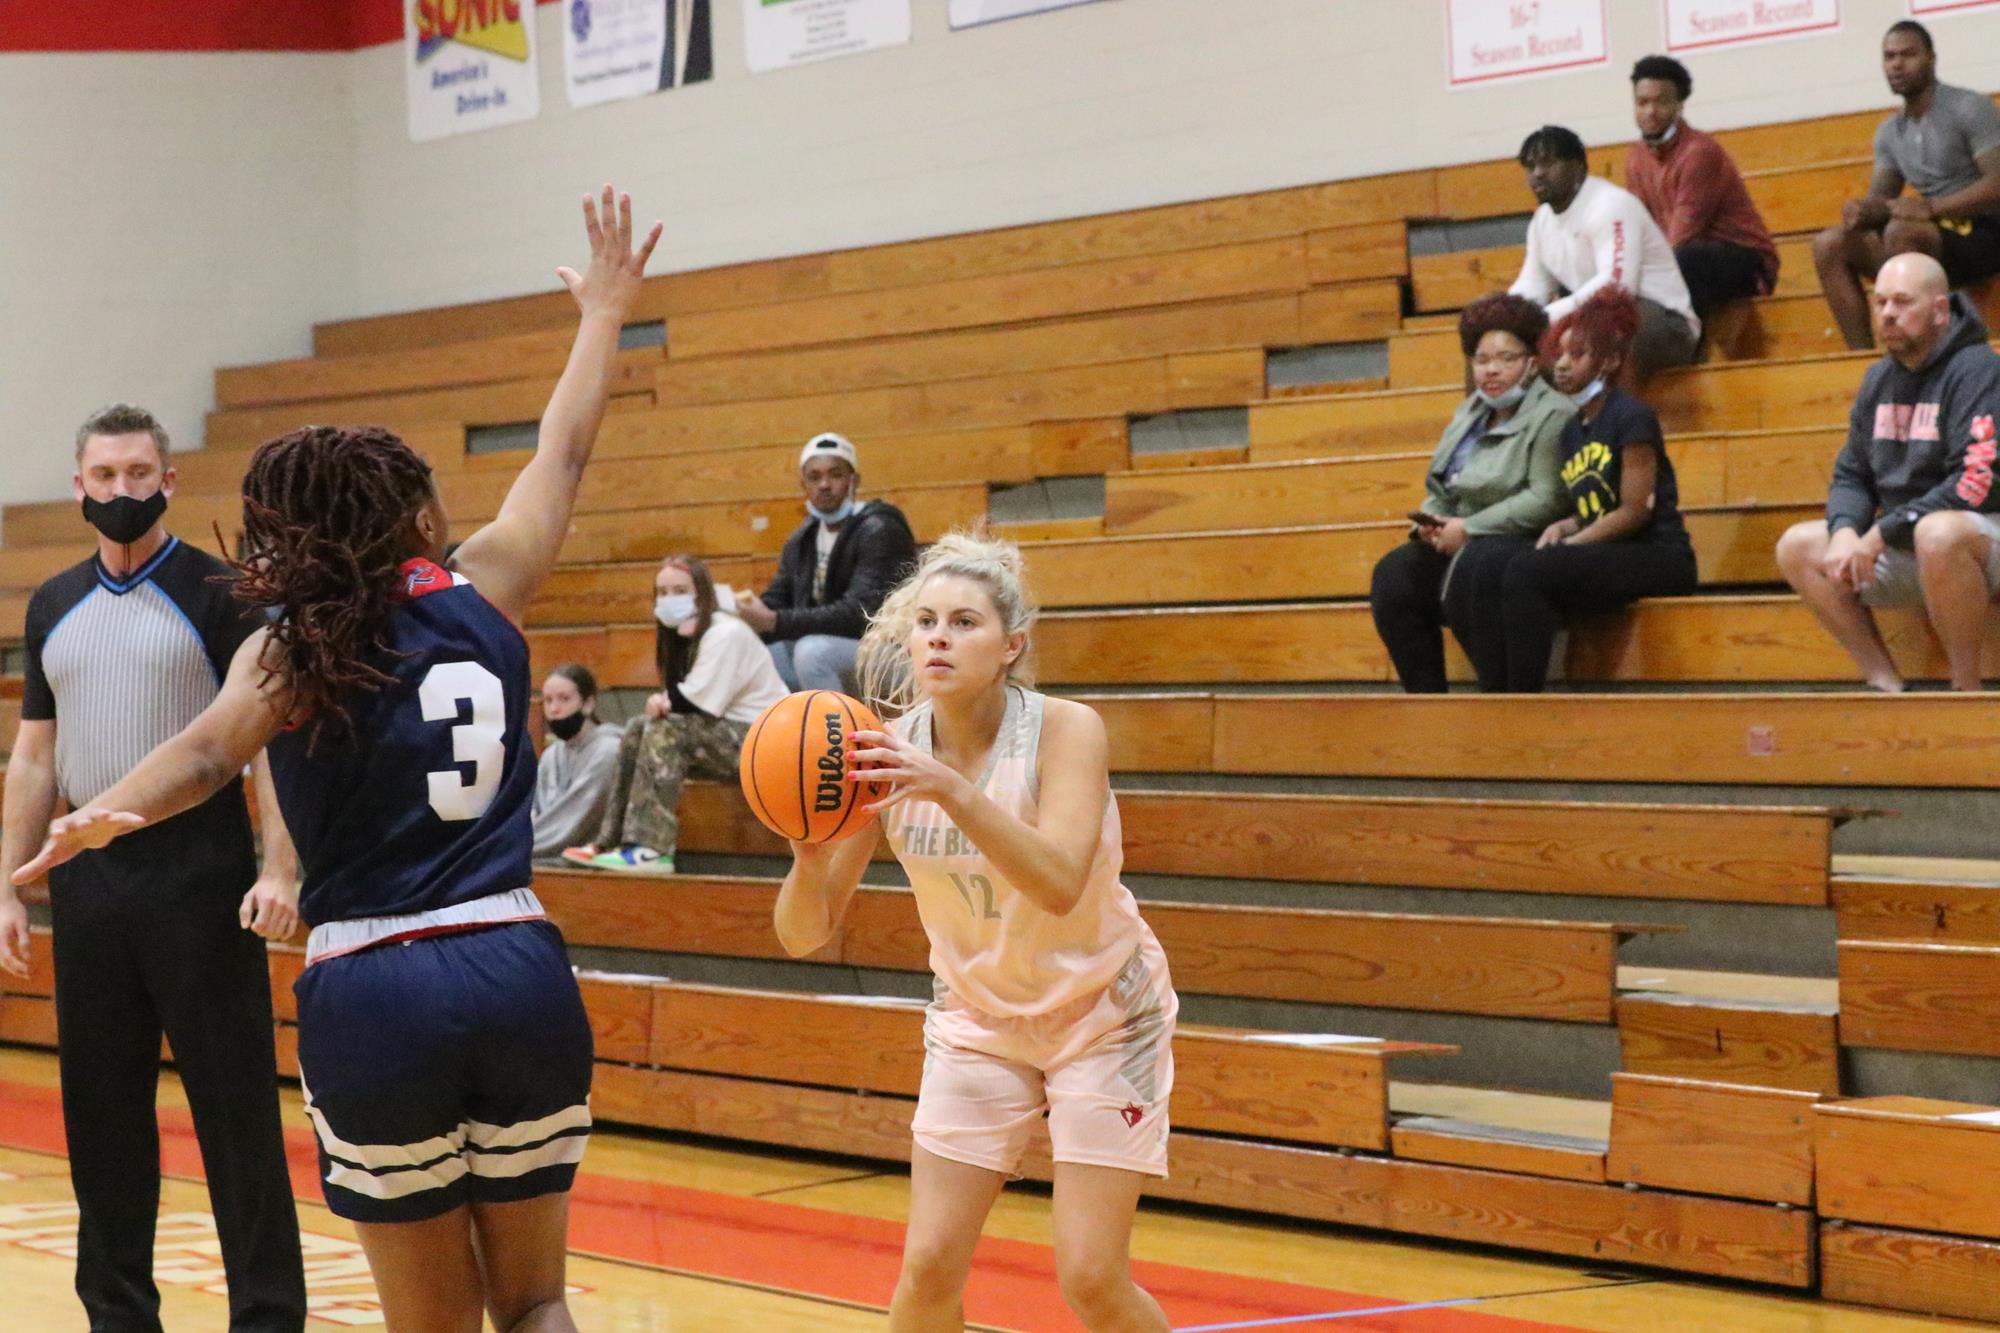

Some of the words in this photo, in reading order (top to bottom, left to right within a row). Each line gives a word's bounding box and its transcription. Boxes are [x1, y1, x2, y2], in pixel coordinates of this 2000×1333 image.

[418, 661, 506, 821] 3
[814, 712, 844, 813] Wilson
[903, 825, 940, 856] THE
[944, 827, 980, 856] BE
[947, 872, 1002, 920] 12
